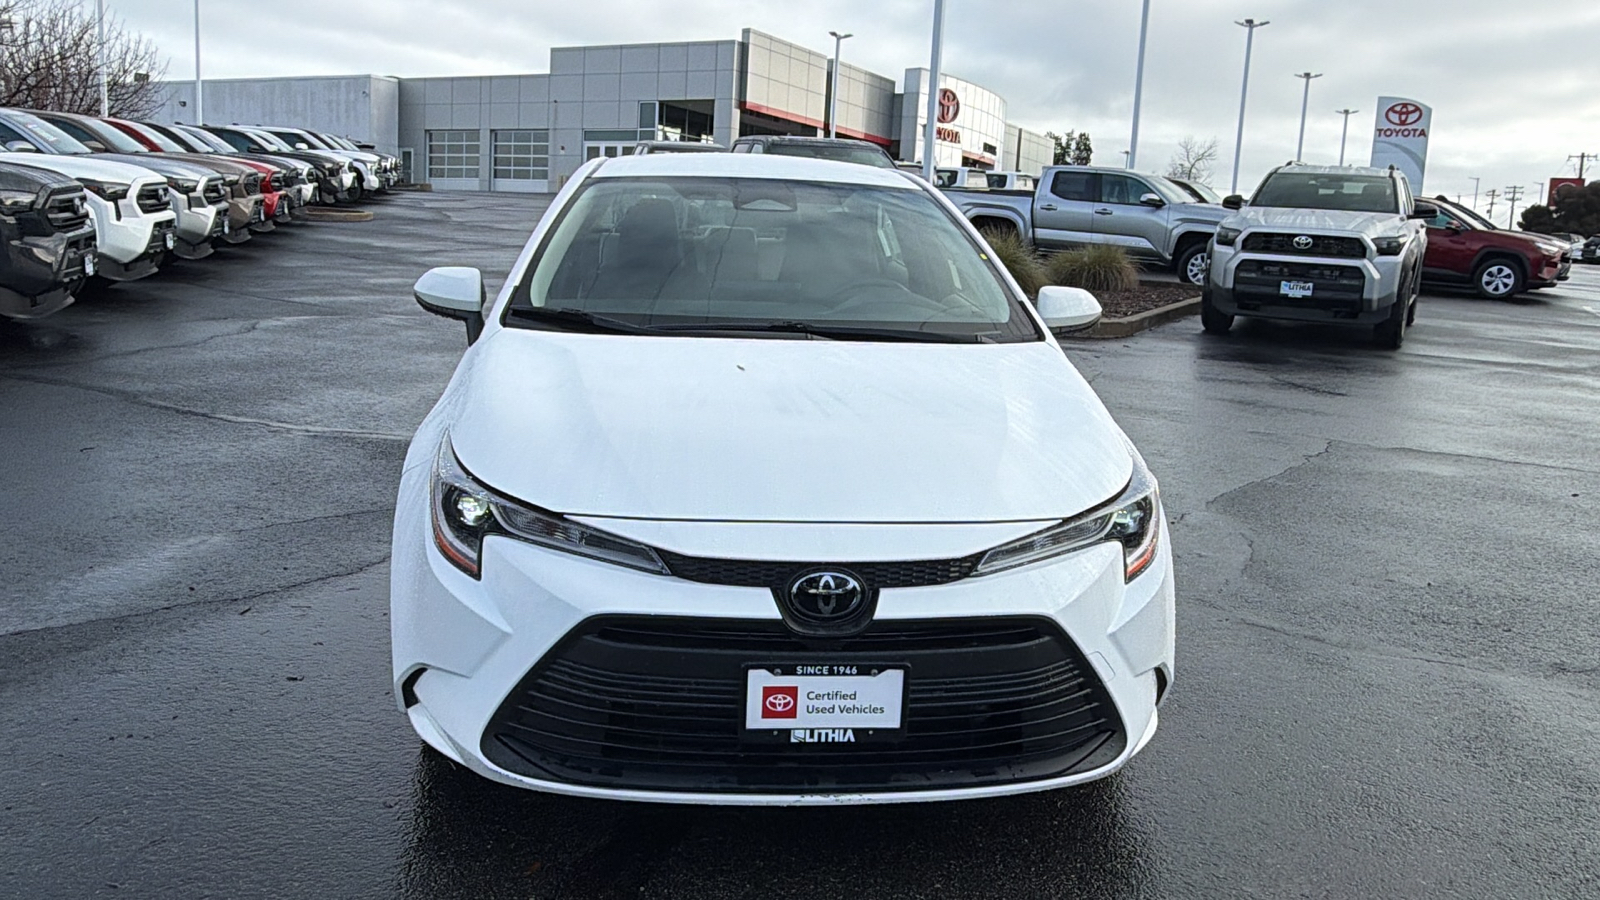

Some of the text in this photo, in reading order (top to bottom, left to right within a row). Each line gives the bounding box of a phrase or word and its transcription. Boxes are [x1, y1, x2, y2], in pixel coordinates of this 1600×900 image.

[936, 127, 961, 144] YOTA
[1376, 128, 1427, 138] TOYOTA
[1288, 282, 1311, 292] LITHIA
[796, 665, 858, 675] SINCE 1946
[806, 690, 857, 701] Certified
[806, 704, 885, 714] Used Vehicles
[805, 729, 855, 742] LITHIA
